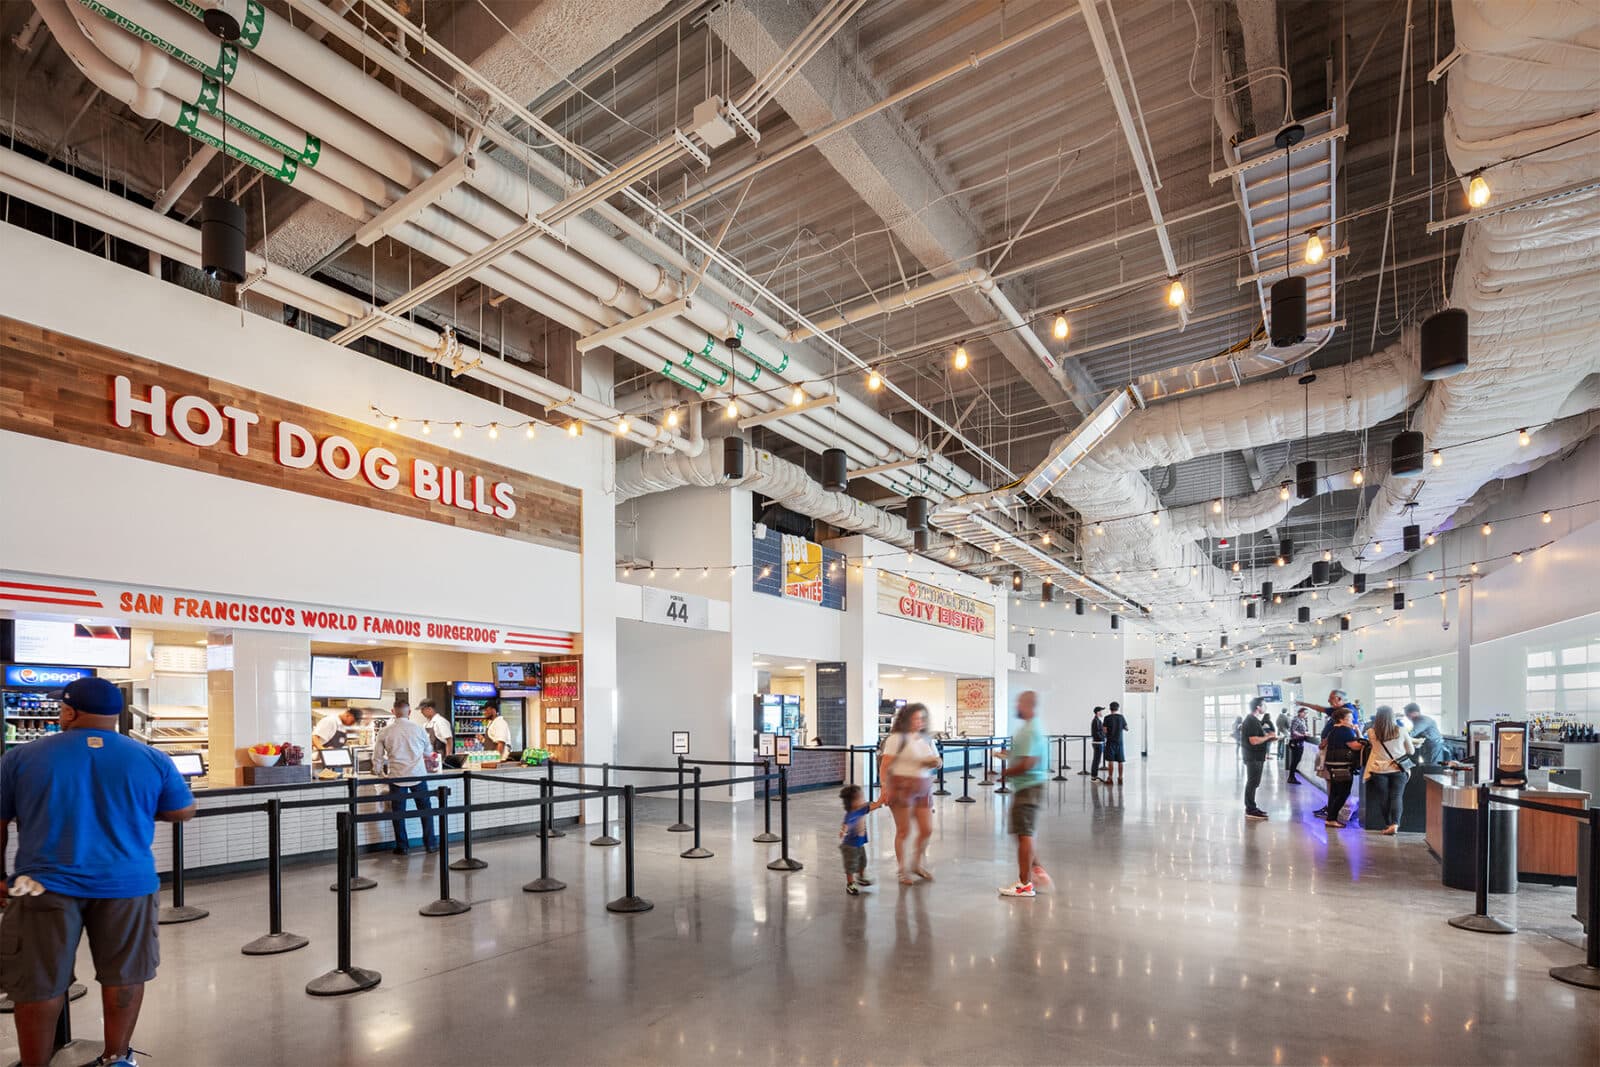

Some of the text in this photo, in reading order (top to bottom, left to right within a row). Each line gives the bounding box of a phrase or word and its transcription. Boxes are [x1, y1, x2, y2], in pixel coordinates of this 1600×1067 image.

[112, 14, 178, 56] RECOVERY
[178, 51, 208, 72] HEAT
[113, 375, 516, 519] HOT DOG BILLS
[120, 591, 164, 615] SAN
[174, 597, 296, 626] FRANCISCO'S
[301, 610, 358, 631] WORLD
[363, 616, 421, 637] FAMOUS
[666, 602, 689, 623] 44
[899, 596, 935, 620] CITY
[938, 606, 985, 633] BISTRO
[39, 671, 81, 684] pepsi
